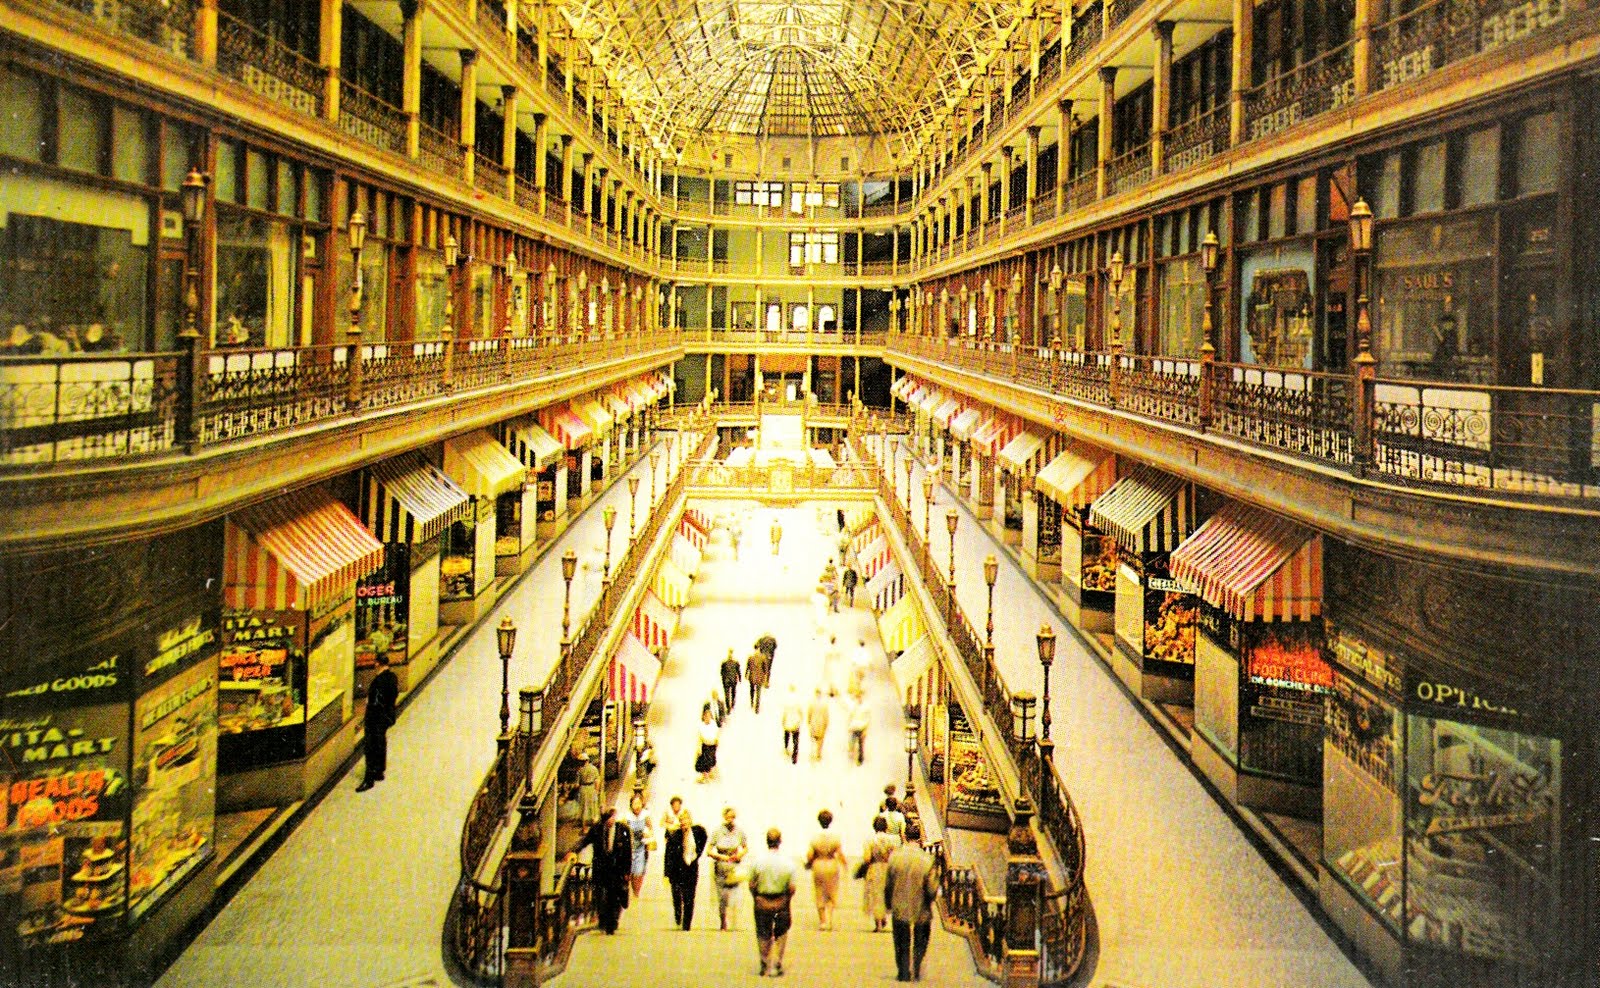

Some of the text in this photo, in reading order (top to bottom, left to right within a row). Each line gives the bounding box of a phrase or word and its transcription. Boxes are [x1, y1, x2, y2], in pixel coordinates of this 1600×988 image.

[234, 624, 297, 641] MART
[1252, 663, 1285, 679] FOOT
[51, 673, 118, 692] GOODS
[23, 737, 118, 762] MART
[10, 769, 105, 805] HEALTH
[18, 795, 99, 828] FOODS
